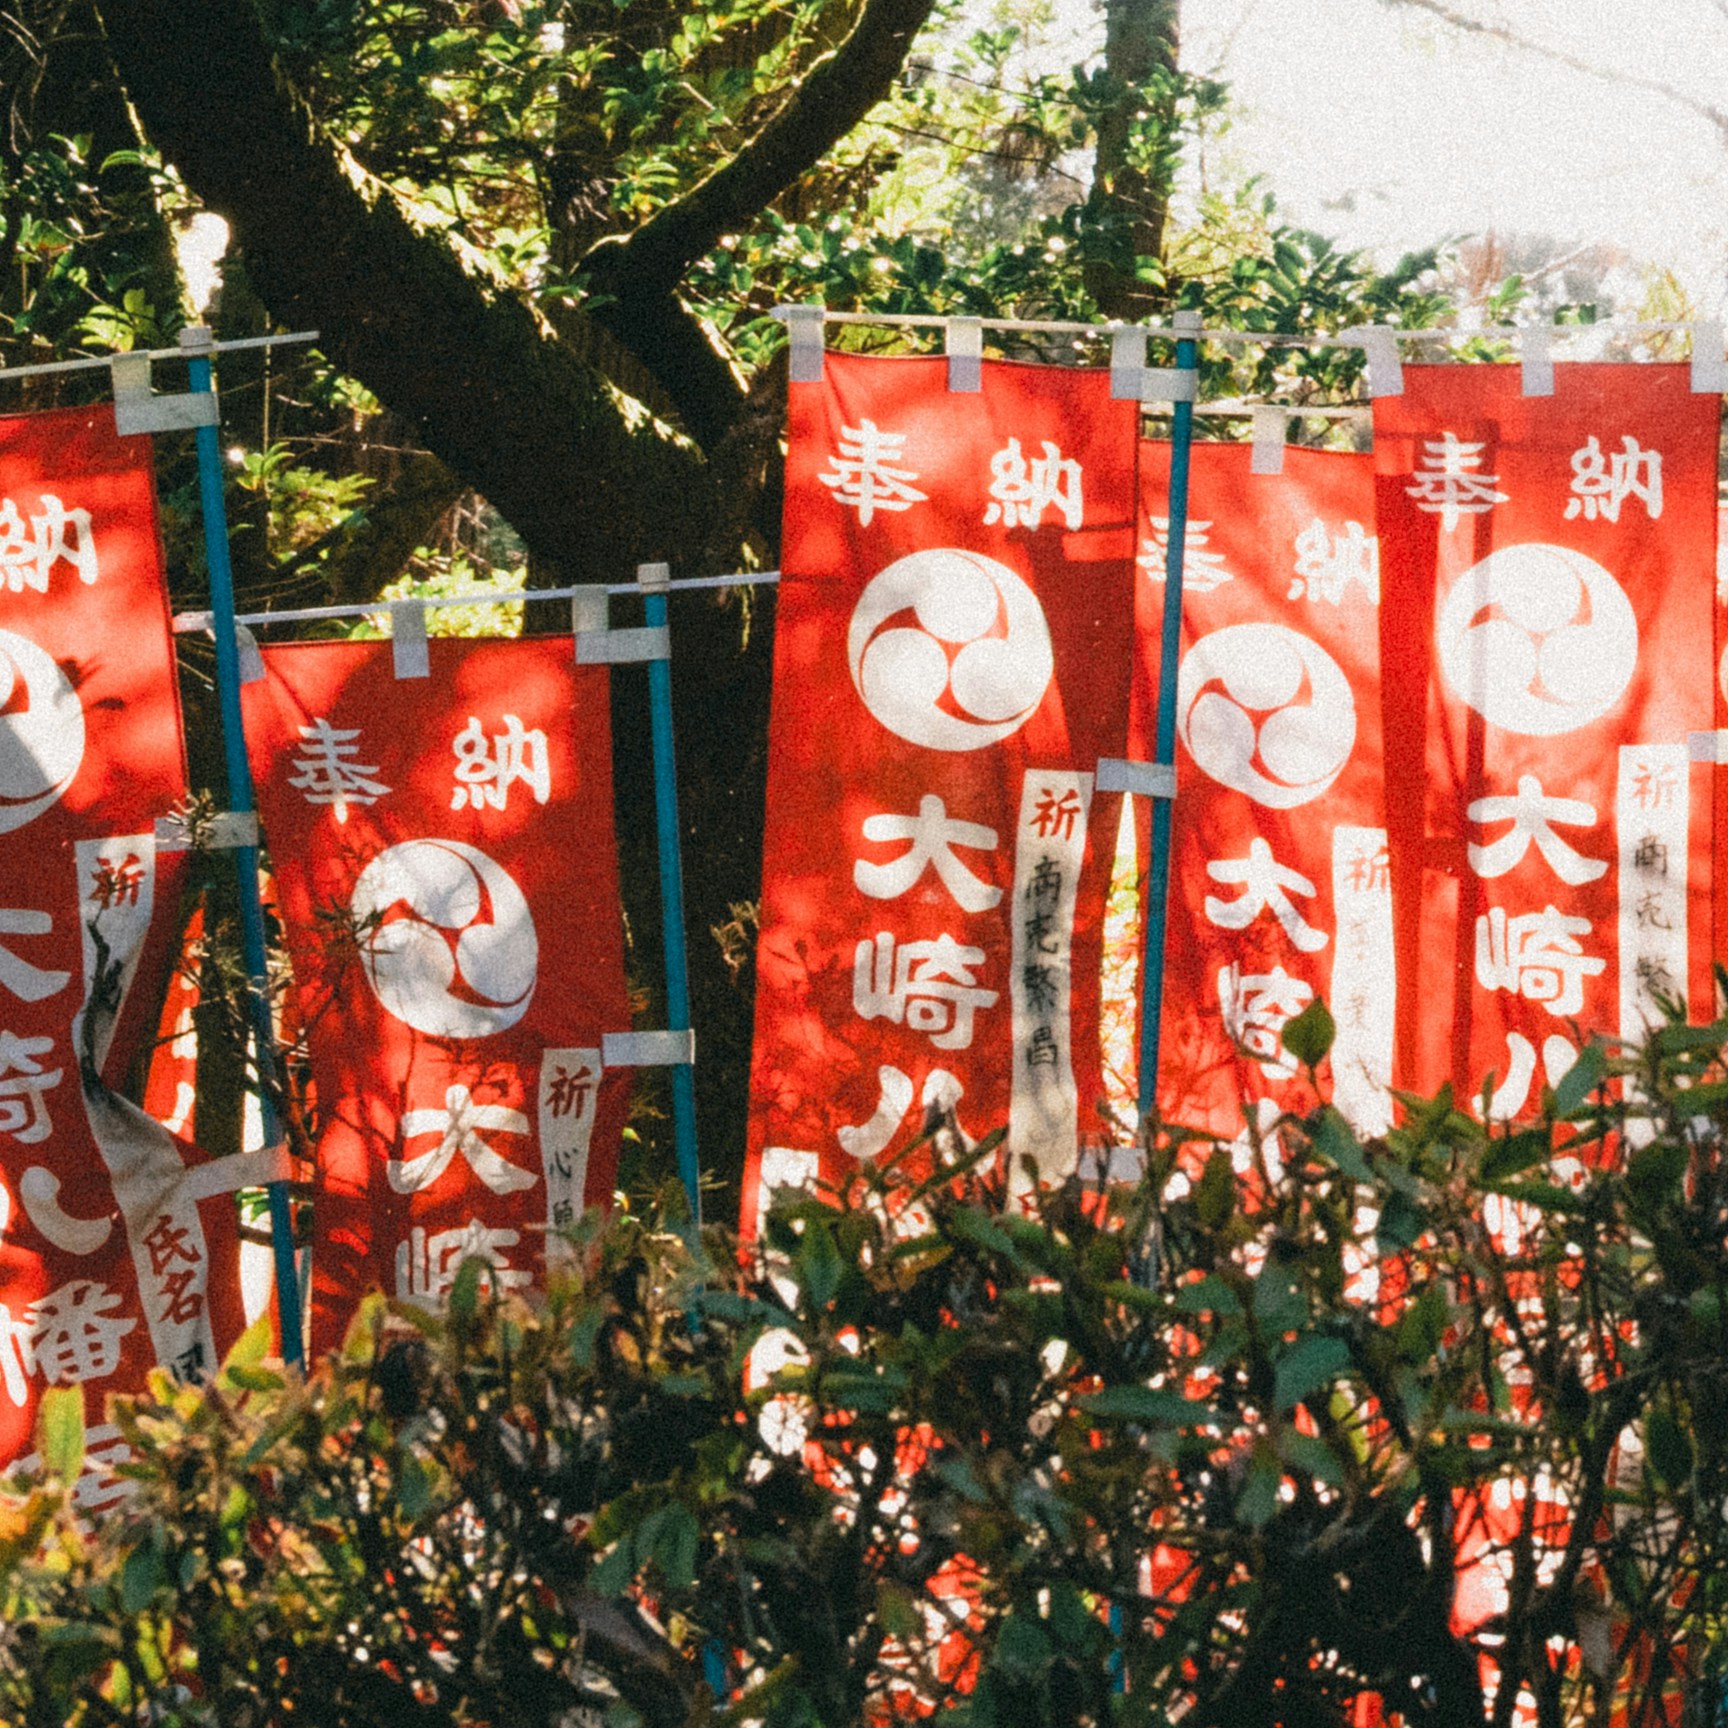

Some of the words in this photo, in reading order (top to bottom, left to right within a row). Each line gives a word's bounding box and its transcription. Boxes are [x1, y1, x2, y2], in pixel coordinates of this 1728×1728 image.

[818, 418, 1082, 533] 奉納
[1405, 430, 1664, 531] 奉納
[290, 714, 551, 824] 奉納
